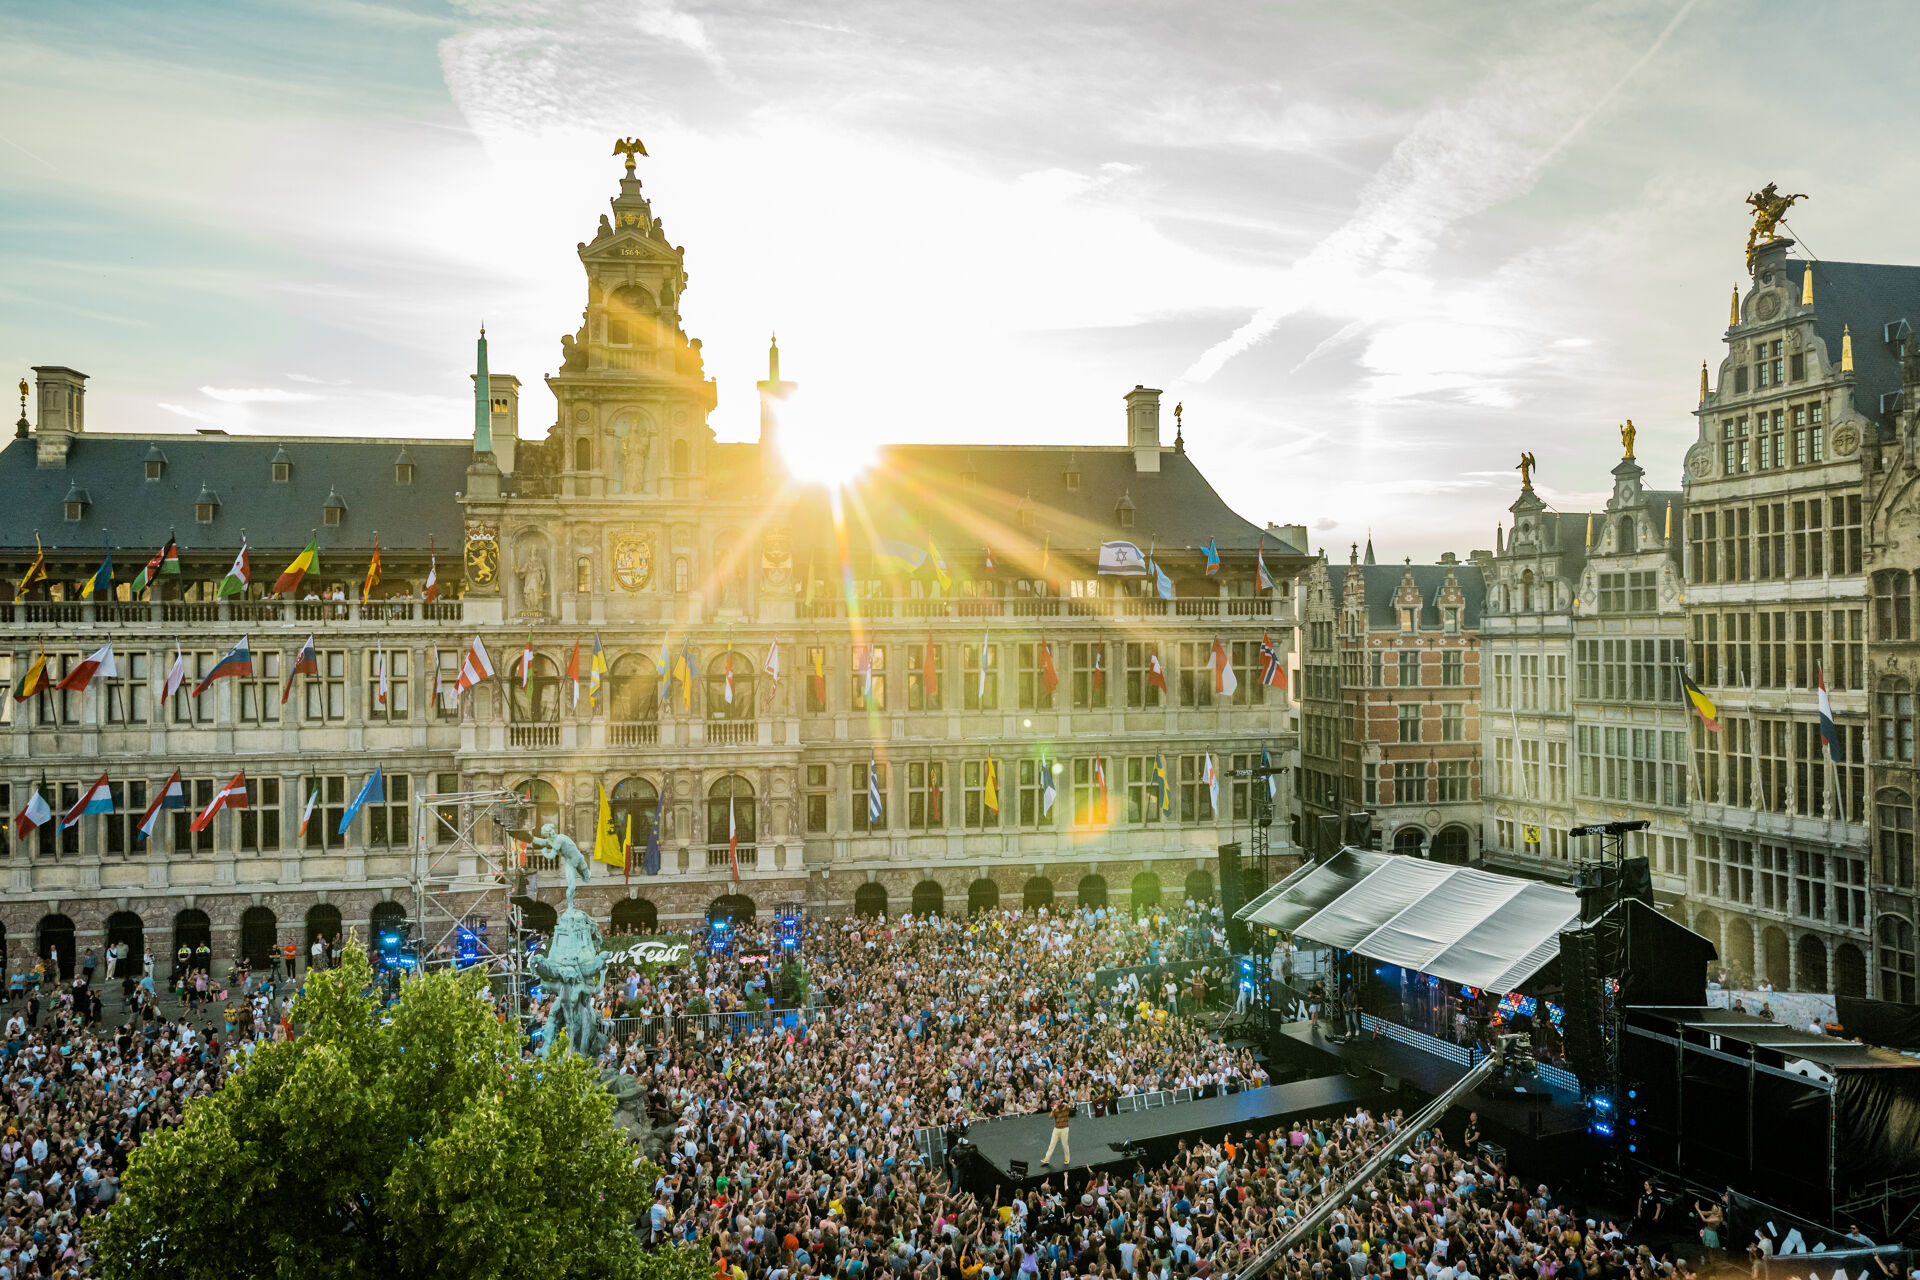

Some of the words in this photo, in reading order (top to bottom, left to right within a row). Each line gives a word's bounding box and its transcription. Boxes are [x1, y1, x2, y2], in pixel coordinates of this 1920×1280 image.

[621, 248, 640, 256] 1564
[1585, 826, 1606, 834] TOWER
[628, 941, 689, 965] Feest
